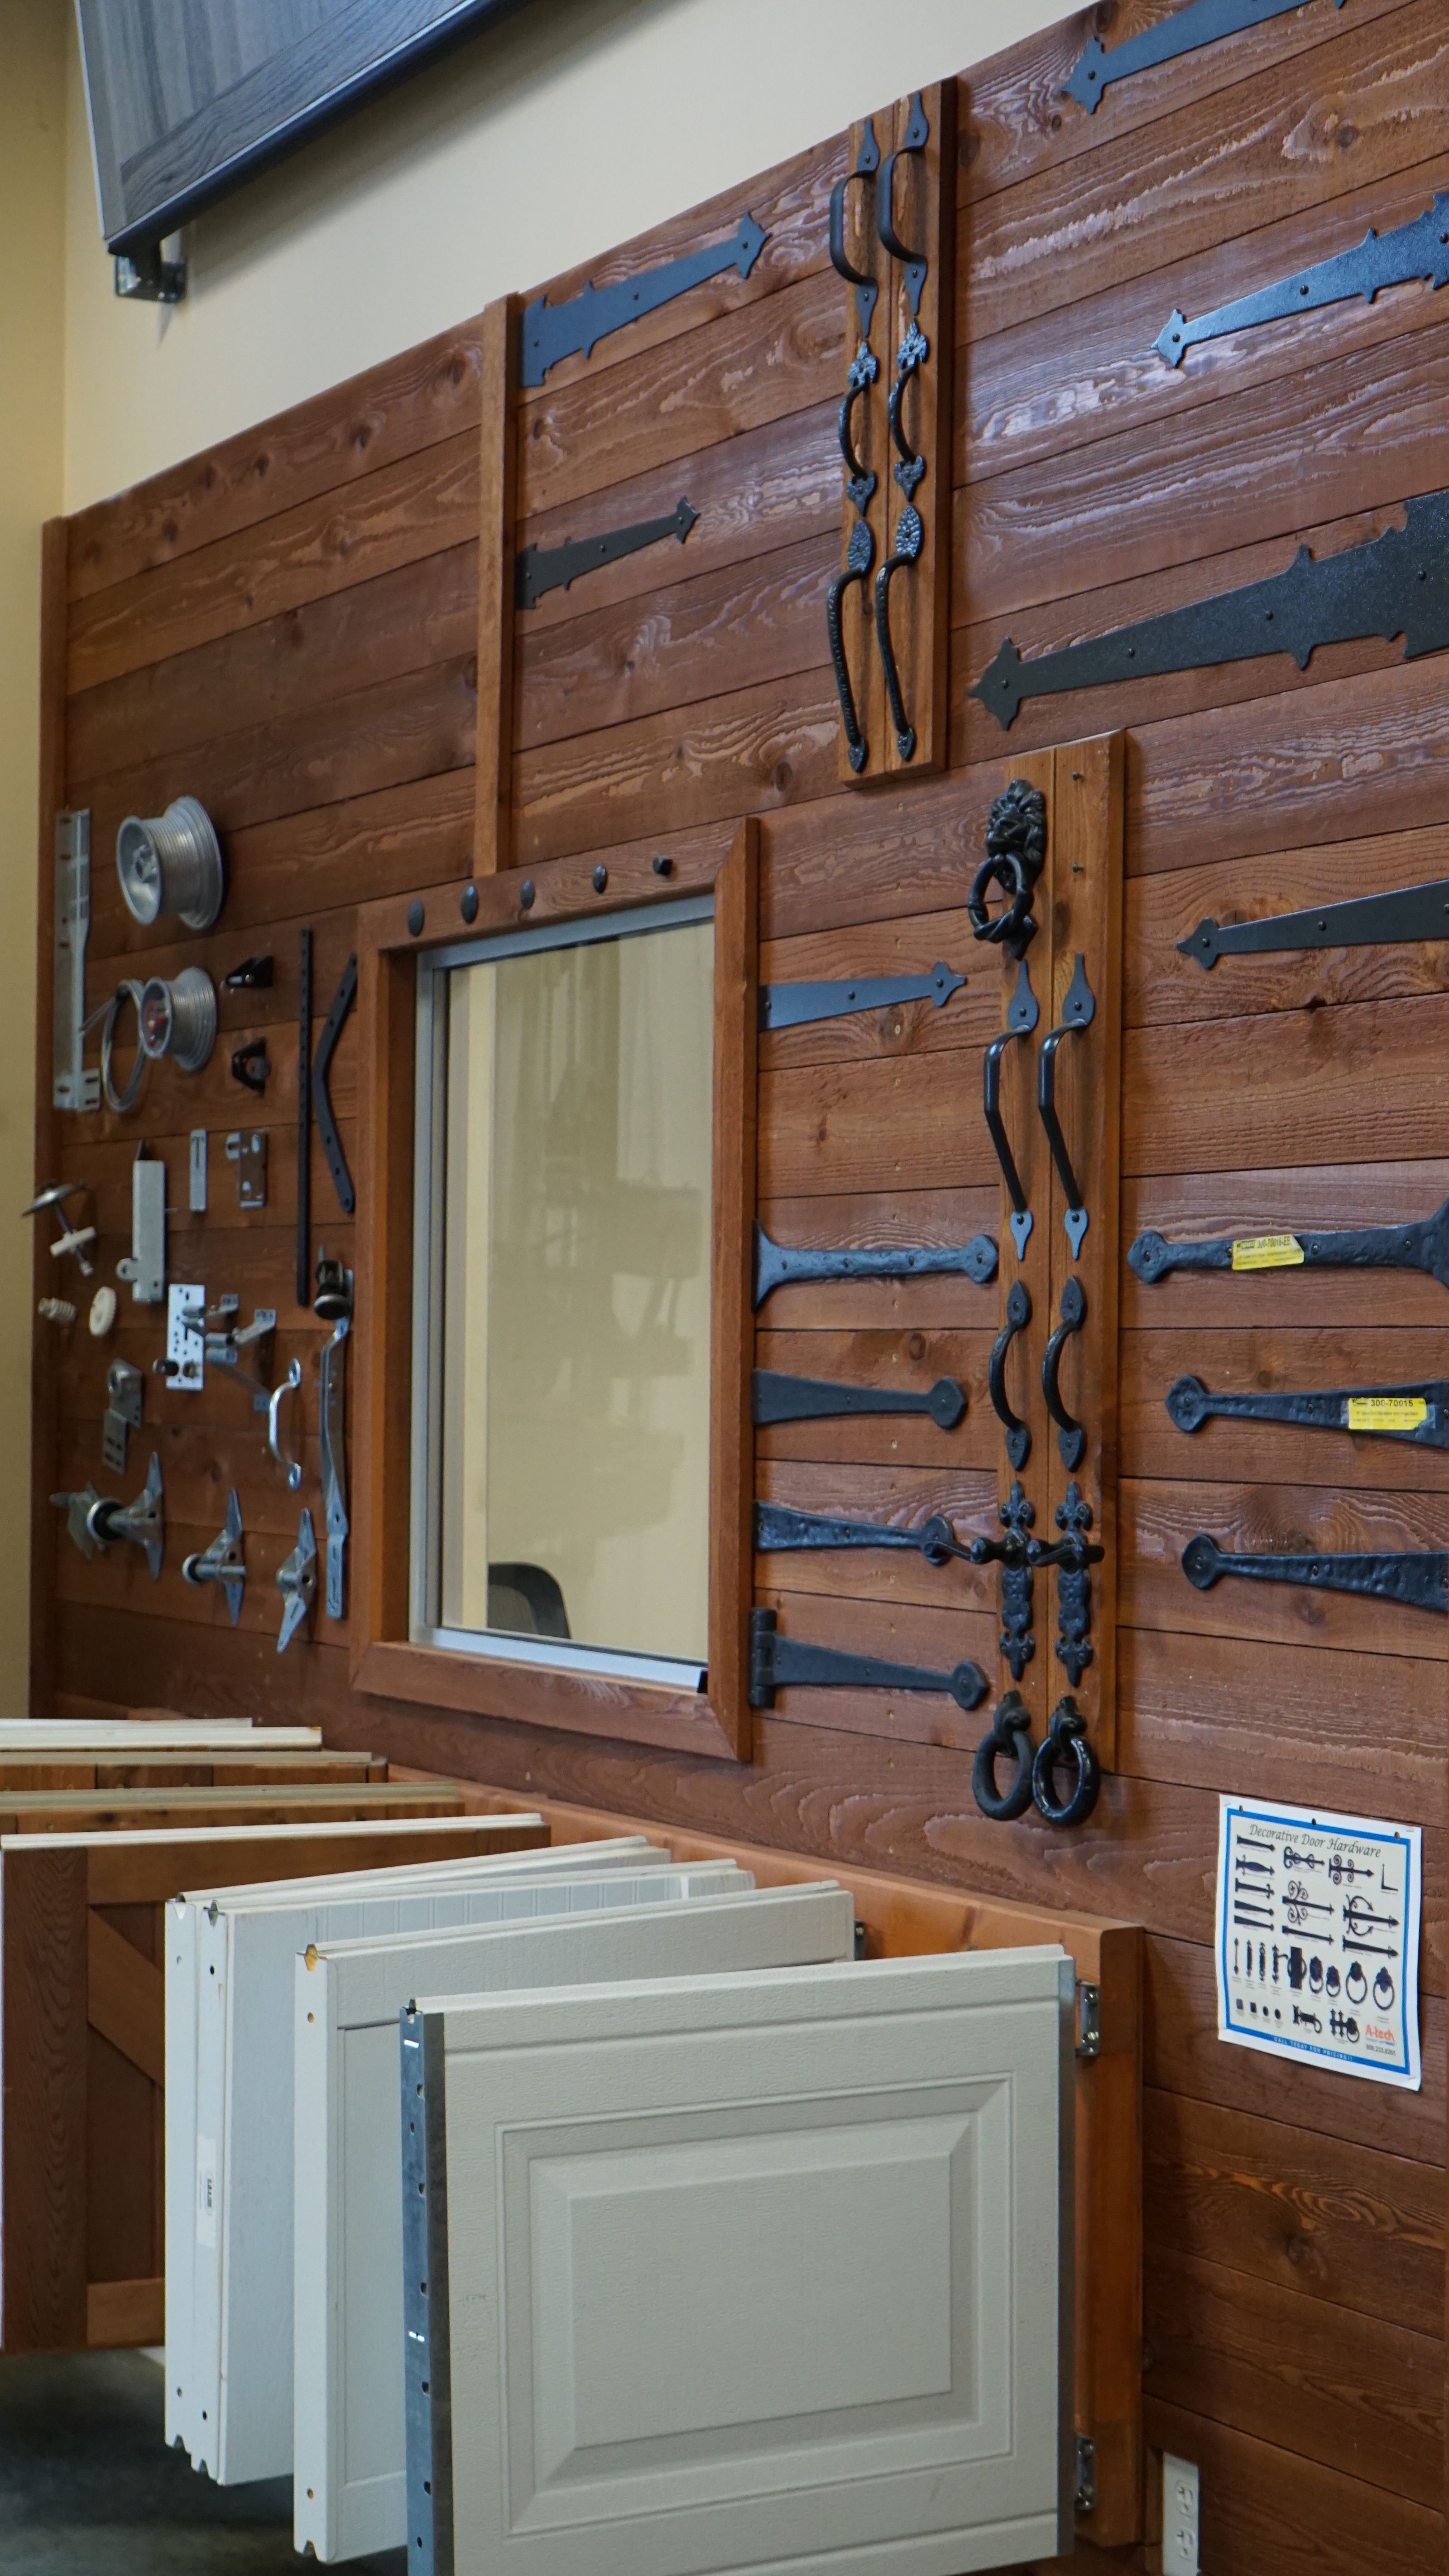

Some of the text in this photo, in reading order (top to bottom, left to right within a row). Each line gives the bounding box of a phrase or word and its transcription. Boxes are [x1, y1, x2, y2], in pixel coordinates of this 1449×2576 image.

[1249, 1824, 1381, 1858] Decorative Door Hardware
[1365, 2024, 1395, 2042] A-tech
[1274, 2037, 1288, 2045] CALL
[1290, 2041, 1307, 2050] TODAY
